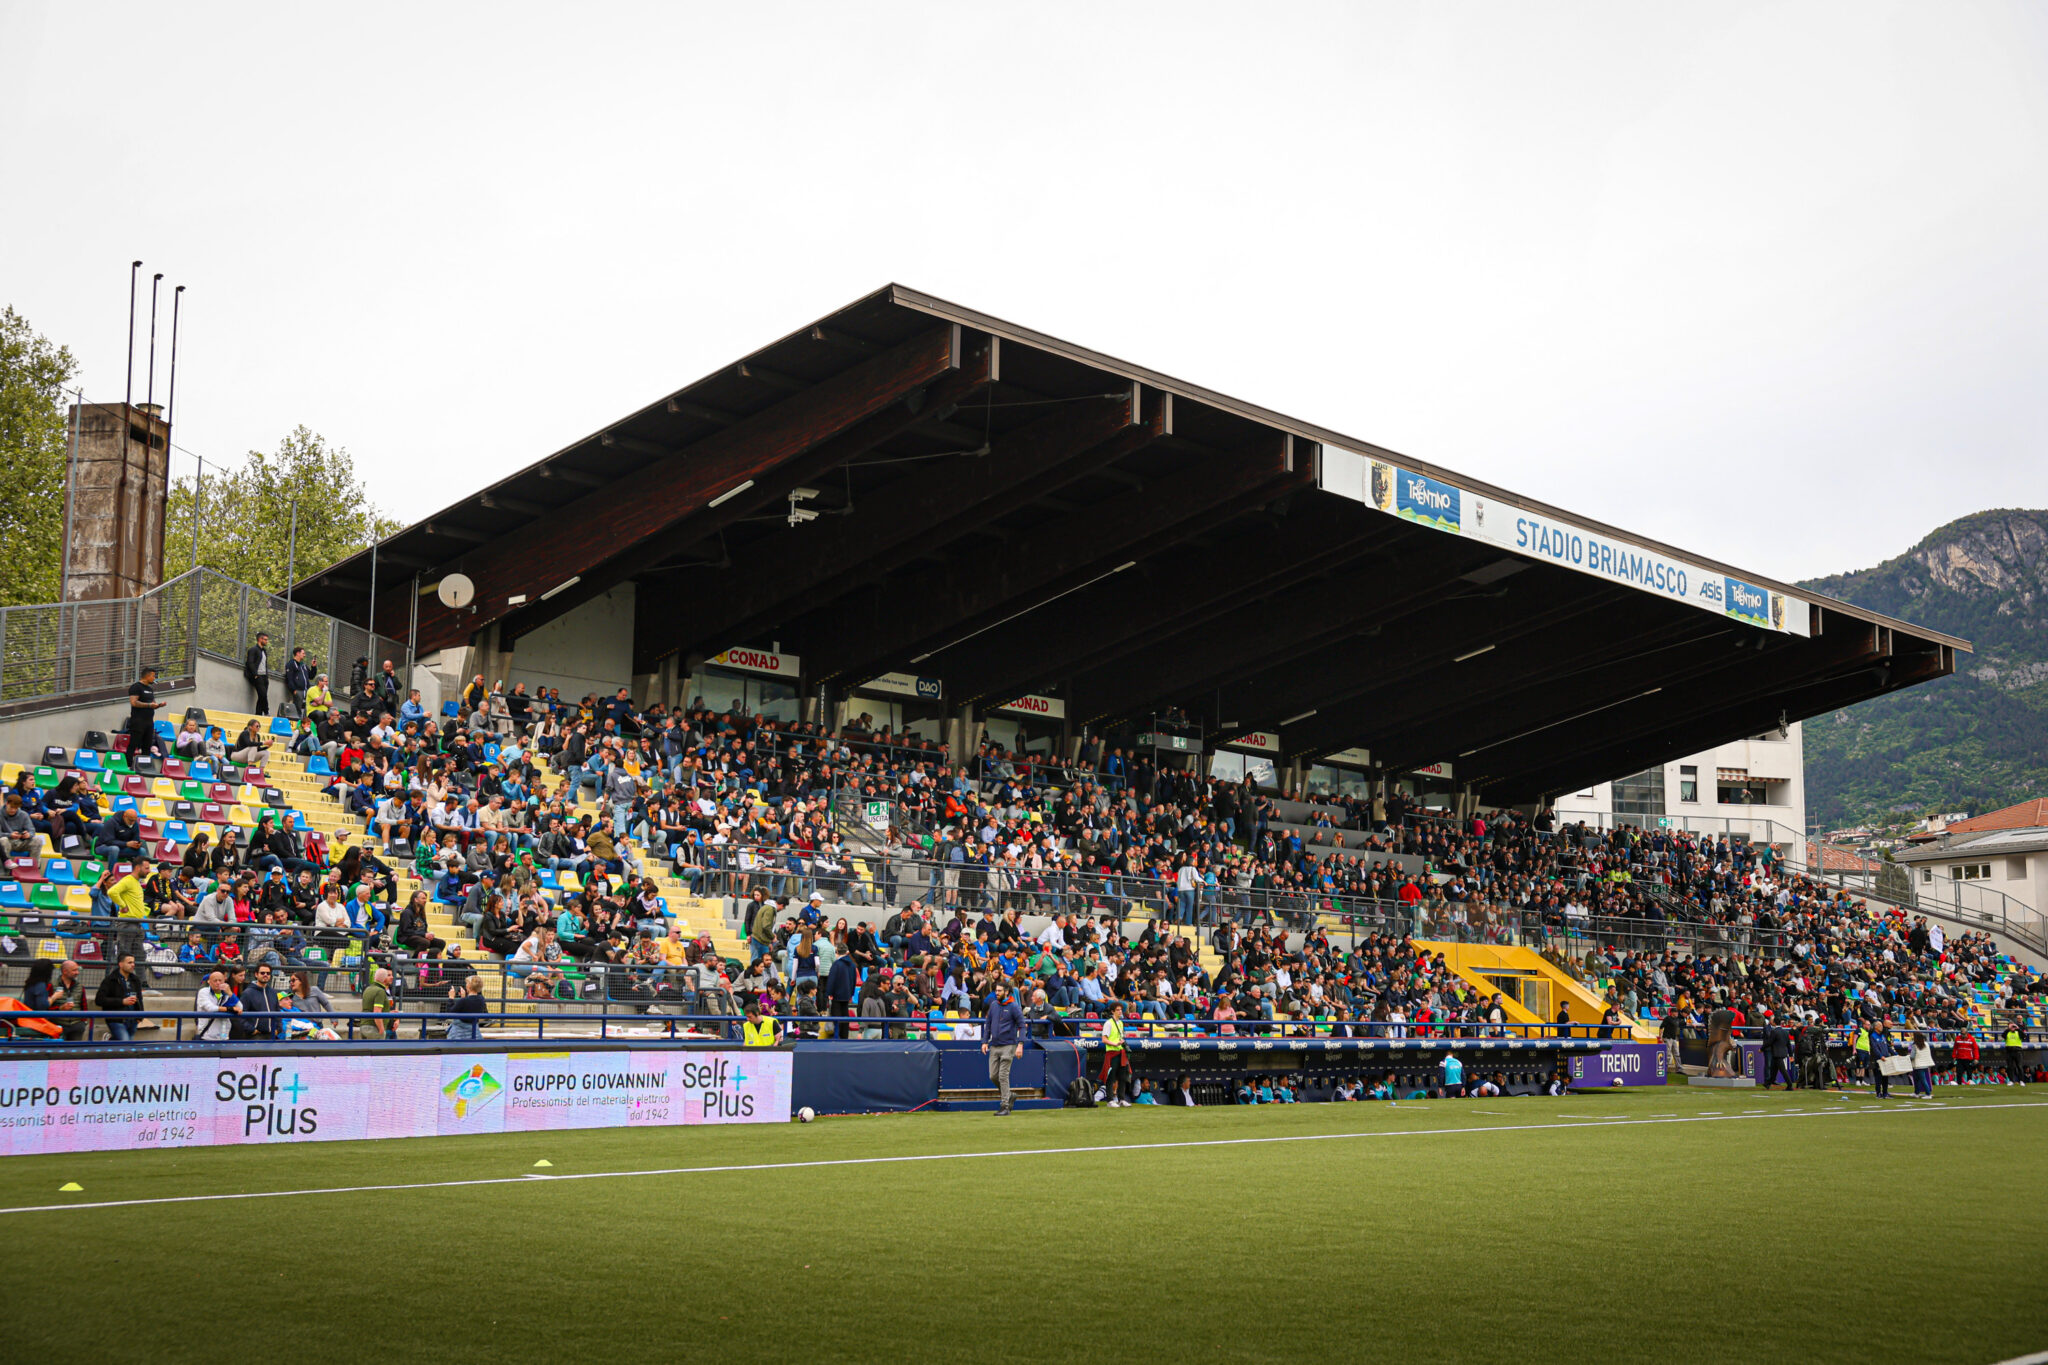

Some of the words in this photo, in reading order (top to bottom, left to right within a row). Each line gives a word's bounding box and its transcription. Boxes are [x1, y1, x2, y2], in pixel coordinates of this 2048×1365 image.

[1407, 480, 1451, 510] TRENTINO
[1516, 518, 1582, 564] STADIO
[1588, 540, 1687, 597] BRIAMASCO
[1731, 585, 1762, 609] TRENTINO
[729, 650, 780, 670] CONAD
[918, 680, 938, 694] DAO
[1235, 733, 1267, 747] ONAD
[1600, 1054, 1640, 1073] TRENTO
[514, 1074, 577, 1091] GRUPPO
[582, 1073, 665, 1090] GIOVANNINI
[69, 1084, 190, 1105] GIOVANNINI
[512, 1095, 573, 1108] Professionisti
[577, 1095, 590, 1106] del
[592, 1094, 634, 1105] materiale
[637, 1094, 670, 1104] elettrico
[704, 1090, 754, 1118] Plus
[60, 1111, 79, 1125] del
[84, 1110, 144, 1123] materiale
[148, 1109, 197, 1122] elettrico
[245, 1103, 318, 1136] Plus
[630, 1110, 644, 1121] dal
[645, 1108, 669, 1120] 1942
[138, 1128, 157, 1142] dal
[161, 1127, 195, 1140] 1942
